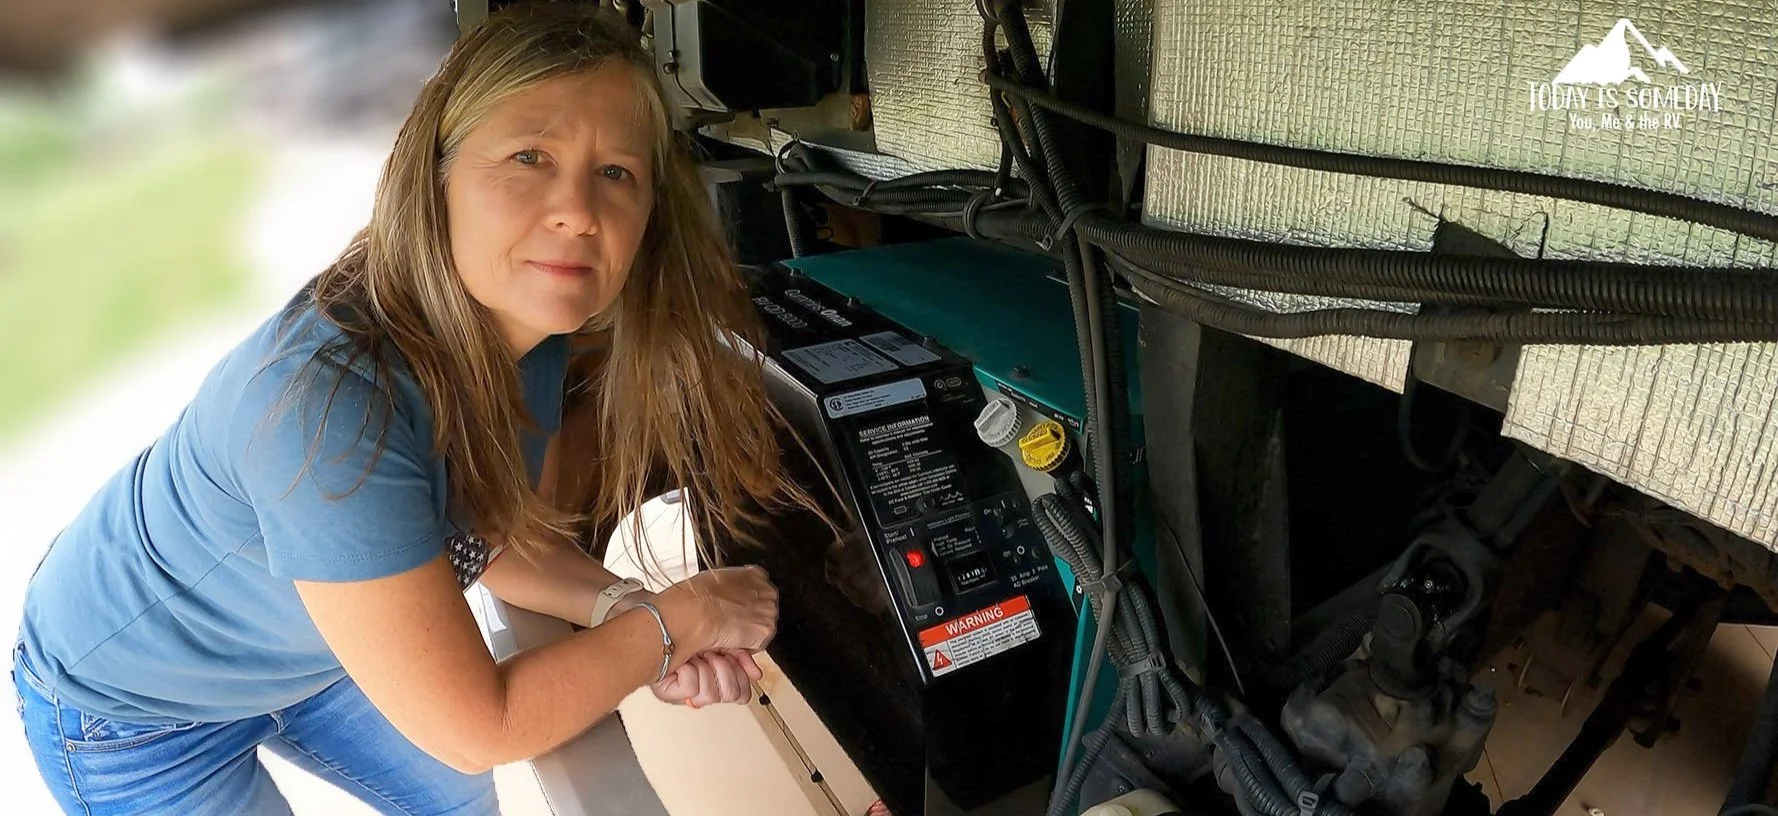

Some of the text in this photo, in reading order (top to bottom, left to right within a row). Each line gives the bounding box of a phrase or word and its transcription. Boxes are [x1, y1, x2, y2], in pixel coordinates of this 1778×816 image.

[821, 309, 852, 327] Onan
[858, 425, 887, 437] SERVICE
[887, 415, 930, 431] INFORMATION
[945, 606, 1004, 636] WARNING
